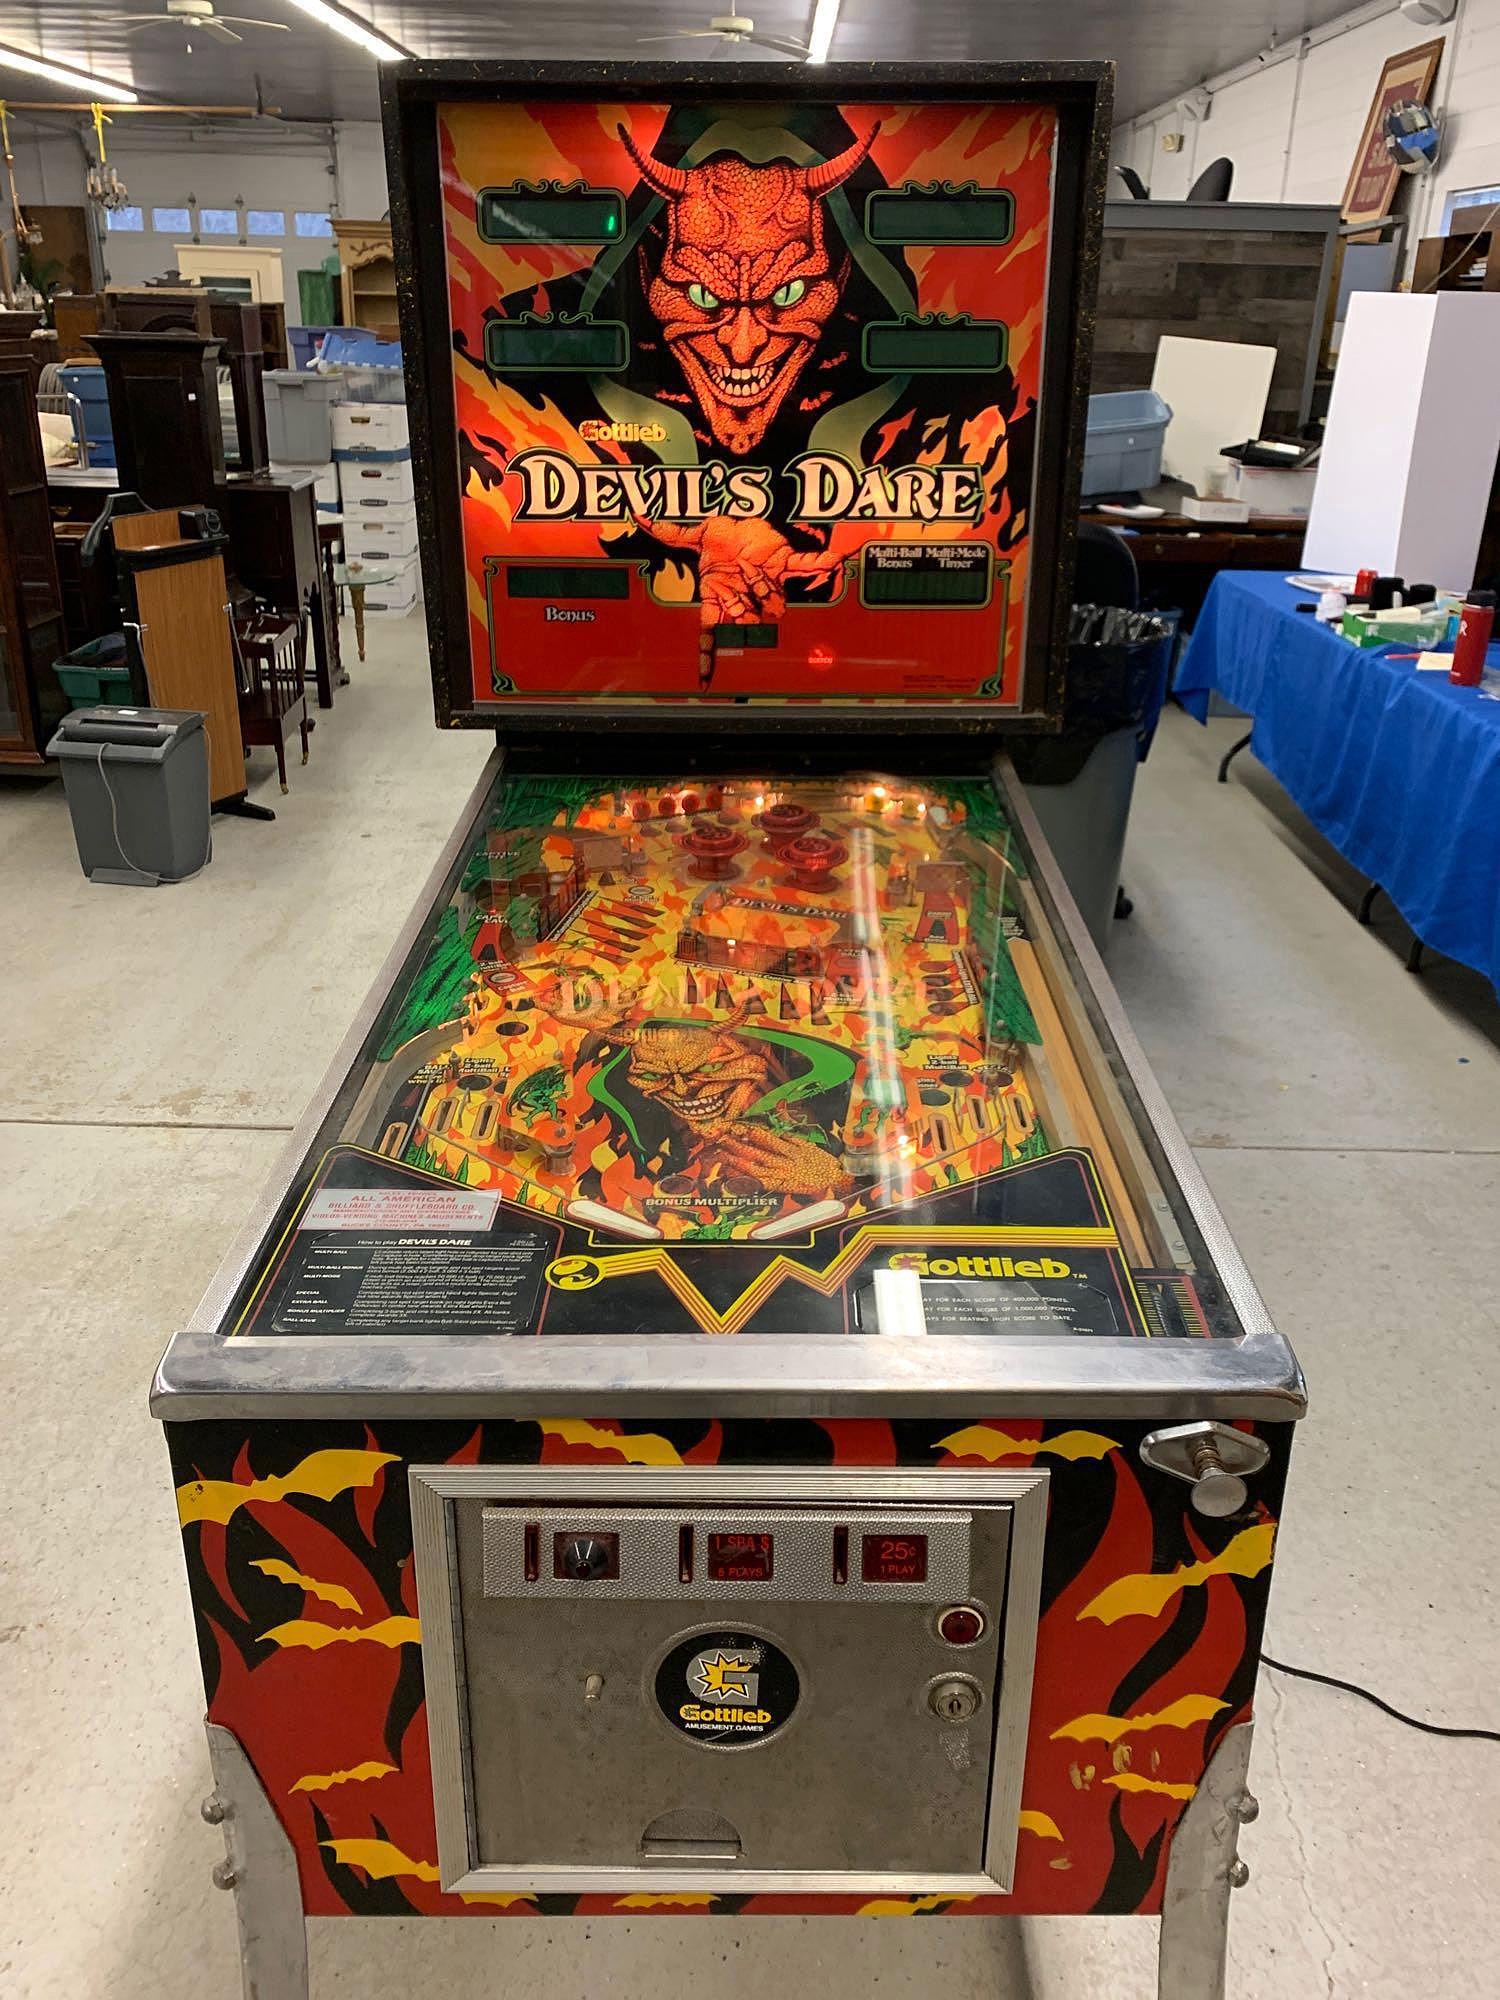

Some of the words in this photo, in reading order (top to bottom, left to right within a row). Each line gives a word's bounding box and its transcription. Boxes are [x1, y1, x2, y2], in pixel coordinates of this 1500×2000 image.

[578, 420, 667, 441] Gottlieb
[512, 453, 771, 521] DEVIL'S
[785, 453, 984, 521] DARE
[869, 547, 922, 558] Multi-Ball
[926, 547, 986, 558] Multi-Mode
[877, 558, 913, 569] Bonus
[938, 558, 974, 569] Timer
[545, 607, 596, 622] Bonus
[382, 1195, 457, 1203] AMERICAN
[645, 1198, 691, 1206] BONUS
[694, 1198, 778, 1206] MULTIPLIER
[888, 1252, 1071, 1278] Gottlieb
[880, 1541, 917, 1561] 25¢
[728, 1567, 763, 1578] PLAYS
[888, 1565, 915, 1575] PLAY
[679, 1703, 773, 1724] Gottlieb
[684, 1723, 734, 1731] AMUSEMENT
[735, 1724, 764, 1732] GAMES
